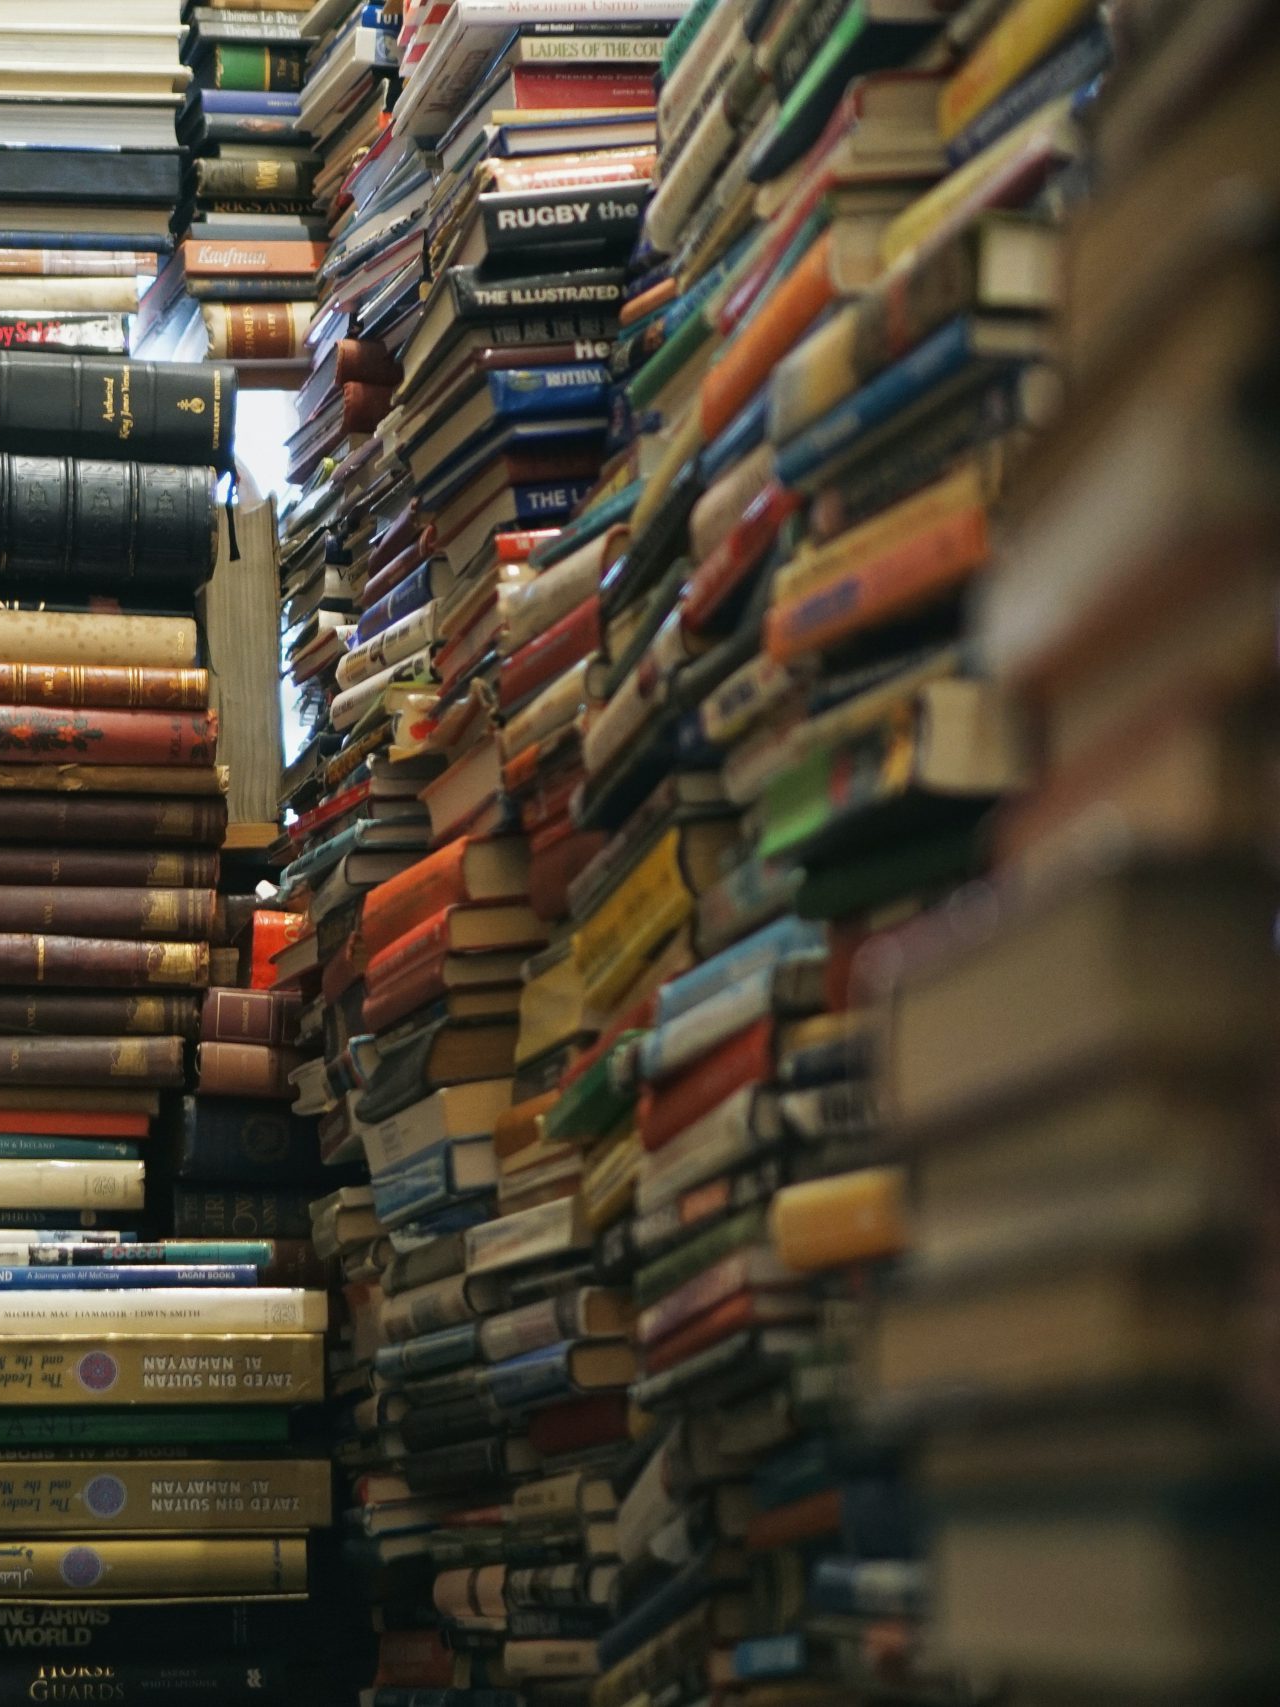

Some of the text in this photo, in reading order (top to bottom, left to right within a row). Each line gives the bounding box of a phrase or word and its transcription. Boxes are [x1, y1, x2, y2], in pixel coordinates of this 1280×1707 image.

[593, 0, 639, 10] UNITED
[261, 10, 273, 23] Le
[277, 11, 297, 24] Prat
[530, 43, 579, 57] LADIES
[582, 42, 600, 57] OF
[603, 42, 630, 57] THE
[497, 201, 638, 229] RUGBY the
[475, 284, 619, 305] THE ILLUSTRATED
[121, 394, 133, 417] James
[528, 489, 567, 509] THE
[19, 1142, 55, 1150] IRELAND
[101, 1246, 165, 1260] soccer
[27, 1272, 34, 1280] A
[35, 1271, 60, 1282] Journey
[62, 1271, 76, 1280] with
[77, 1271, 88, 1280] Alf
[177, 1271, 236, 1280] LAGAN BOOKS
[170, 1310, 201, 1318] SMITH
[15, 1355, 33, 1369] the
[39, 1355, 64, 1367] and
[40, 1373, 64, 1388] The
[143, 1373, 293, 1388] ZAYED BIN SULTAN
[103, 1447, 128, 1458] OF
[22, 1479, 42, 1493] the
[49, 1479, 71, 1492] and
[0, 1498, 71, 1512] The Leader
[150, 1497, 300, 1511] ZAYED BIN SULTAN
[39, 1607, 112, 1626] ARMS
[2, 1627, 92, 1647] WORLD
[29, 1679, 125, 1702] GUARDS
